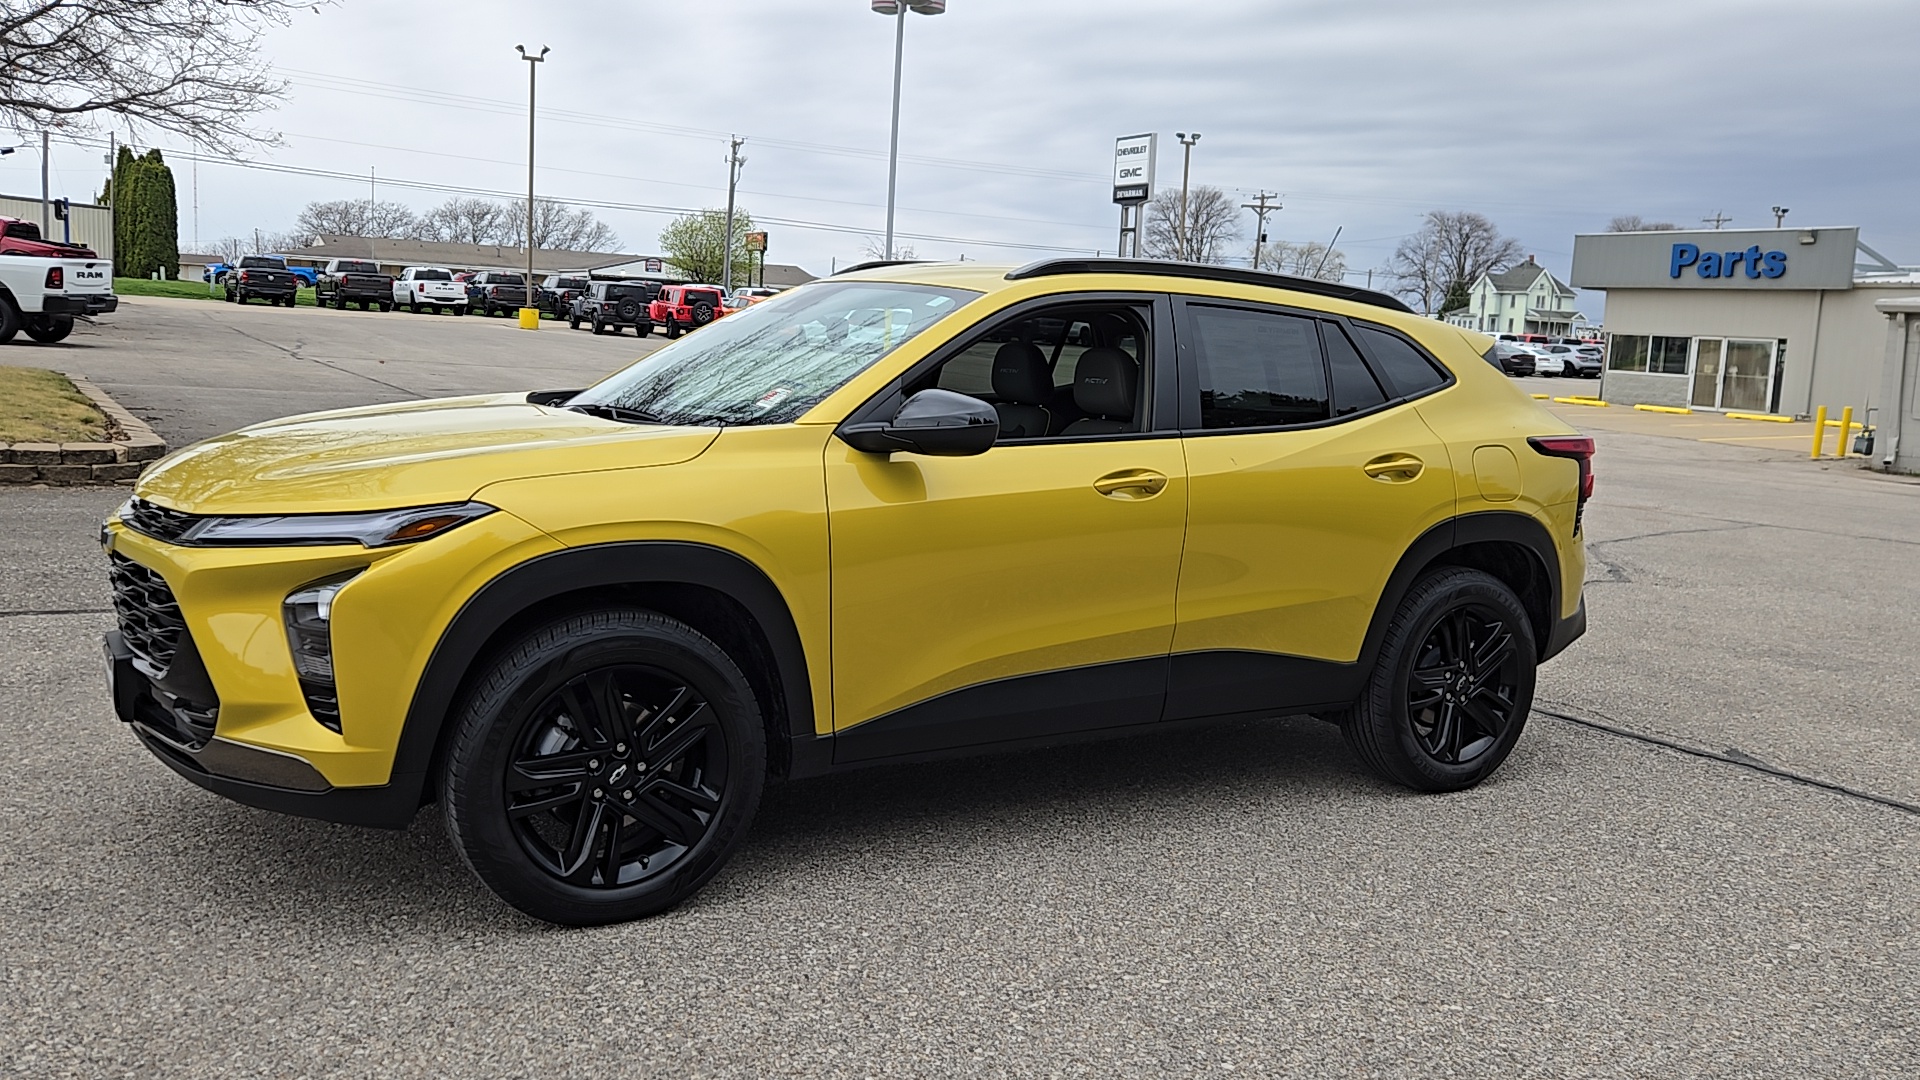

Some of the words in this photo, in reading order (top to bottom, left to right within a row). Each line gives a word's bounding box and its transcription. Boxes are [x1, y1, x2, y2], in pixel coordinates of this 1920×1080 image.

[1117, 145, 1147, 156] CHEVROLET
[1119, 167, 1142, 178] GMC
[1670, 243, 1787, 279] Parts
[1084, 377, 1109, 385] ACTIV
